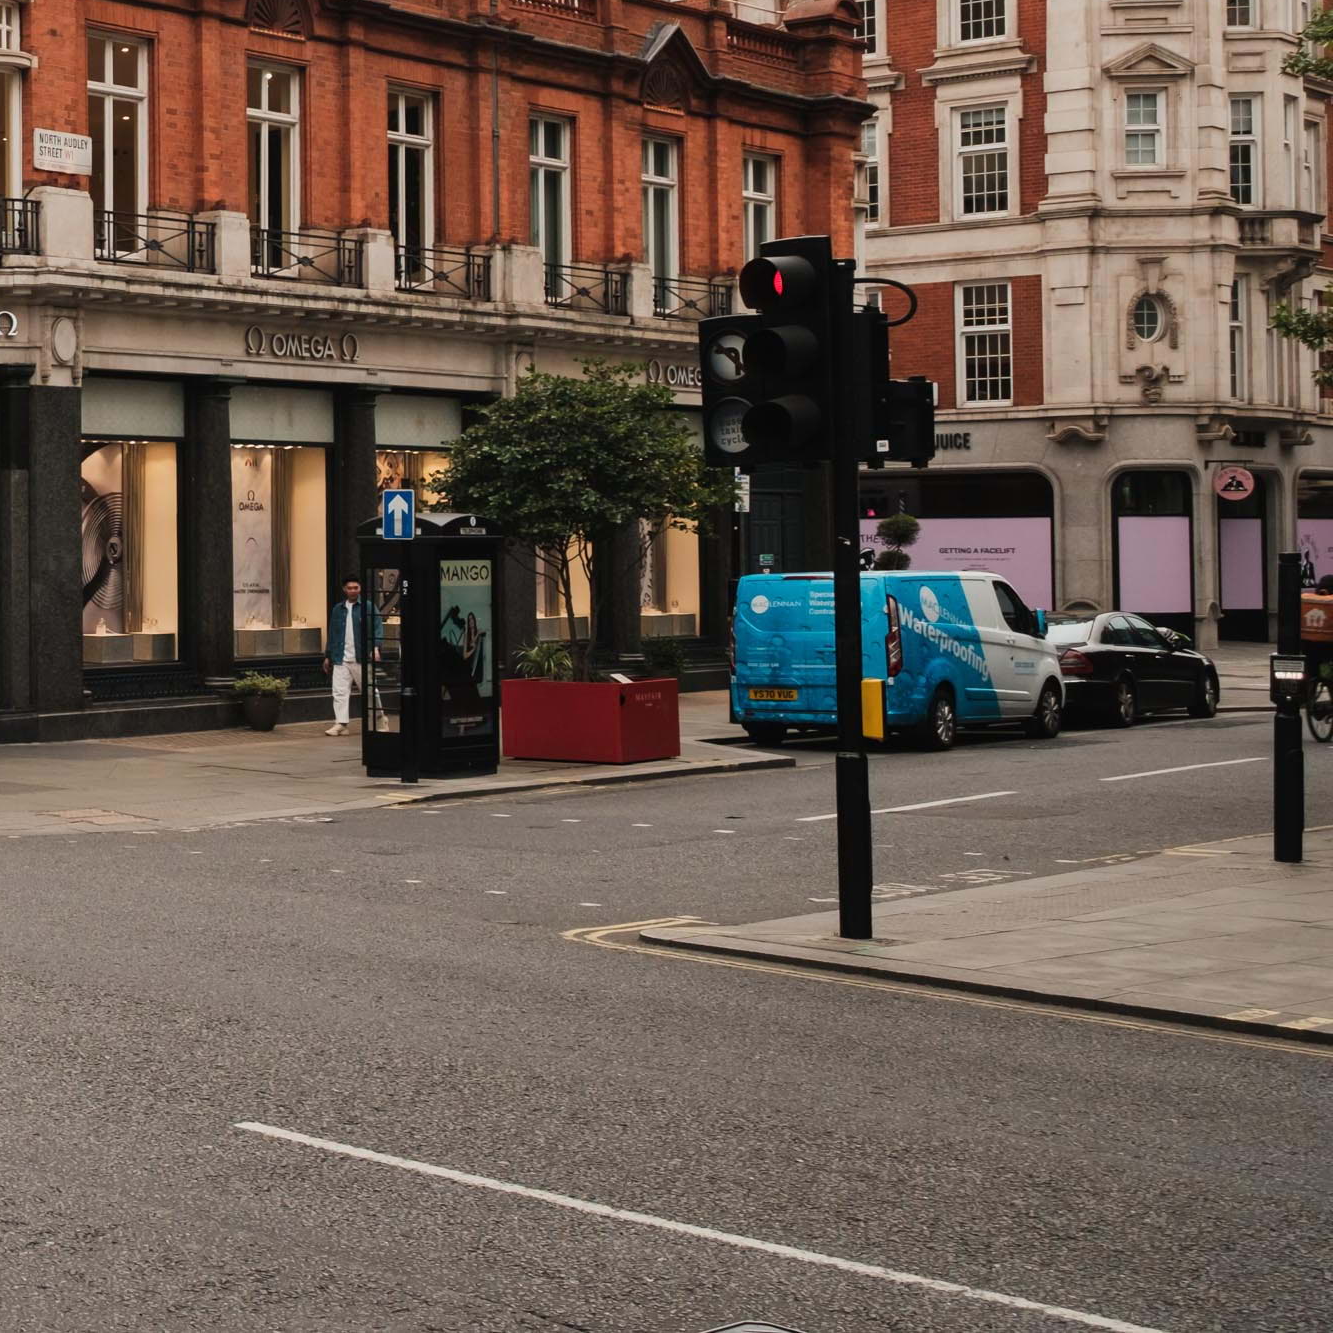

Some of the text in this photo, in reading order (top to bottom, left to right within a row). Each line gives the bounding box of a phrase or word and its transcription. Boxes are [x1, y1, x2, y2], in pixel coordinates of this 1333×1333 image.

[39, 132, 88, 150] NORTH AUDLEY
[39, 146, 62, 158] STREET
[273, 333, 336, 359] OMEGA
[667, 365, 701, 386] OMEG
[239, 502, 264, 511] OMEGA
[860, 534, 879, 544] THE
[440, 565, 489, 581] MANGO
[898, 603, 989, 681] Waterproofing
[753, 690, 775, 699] YS70
